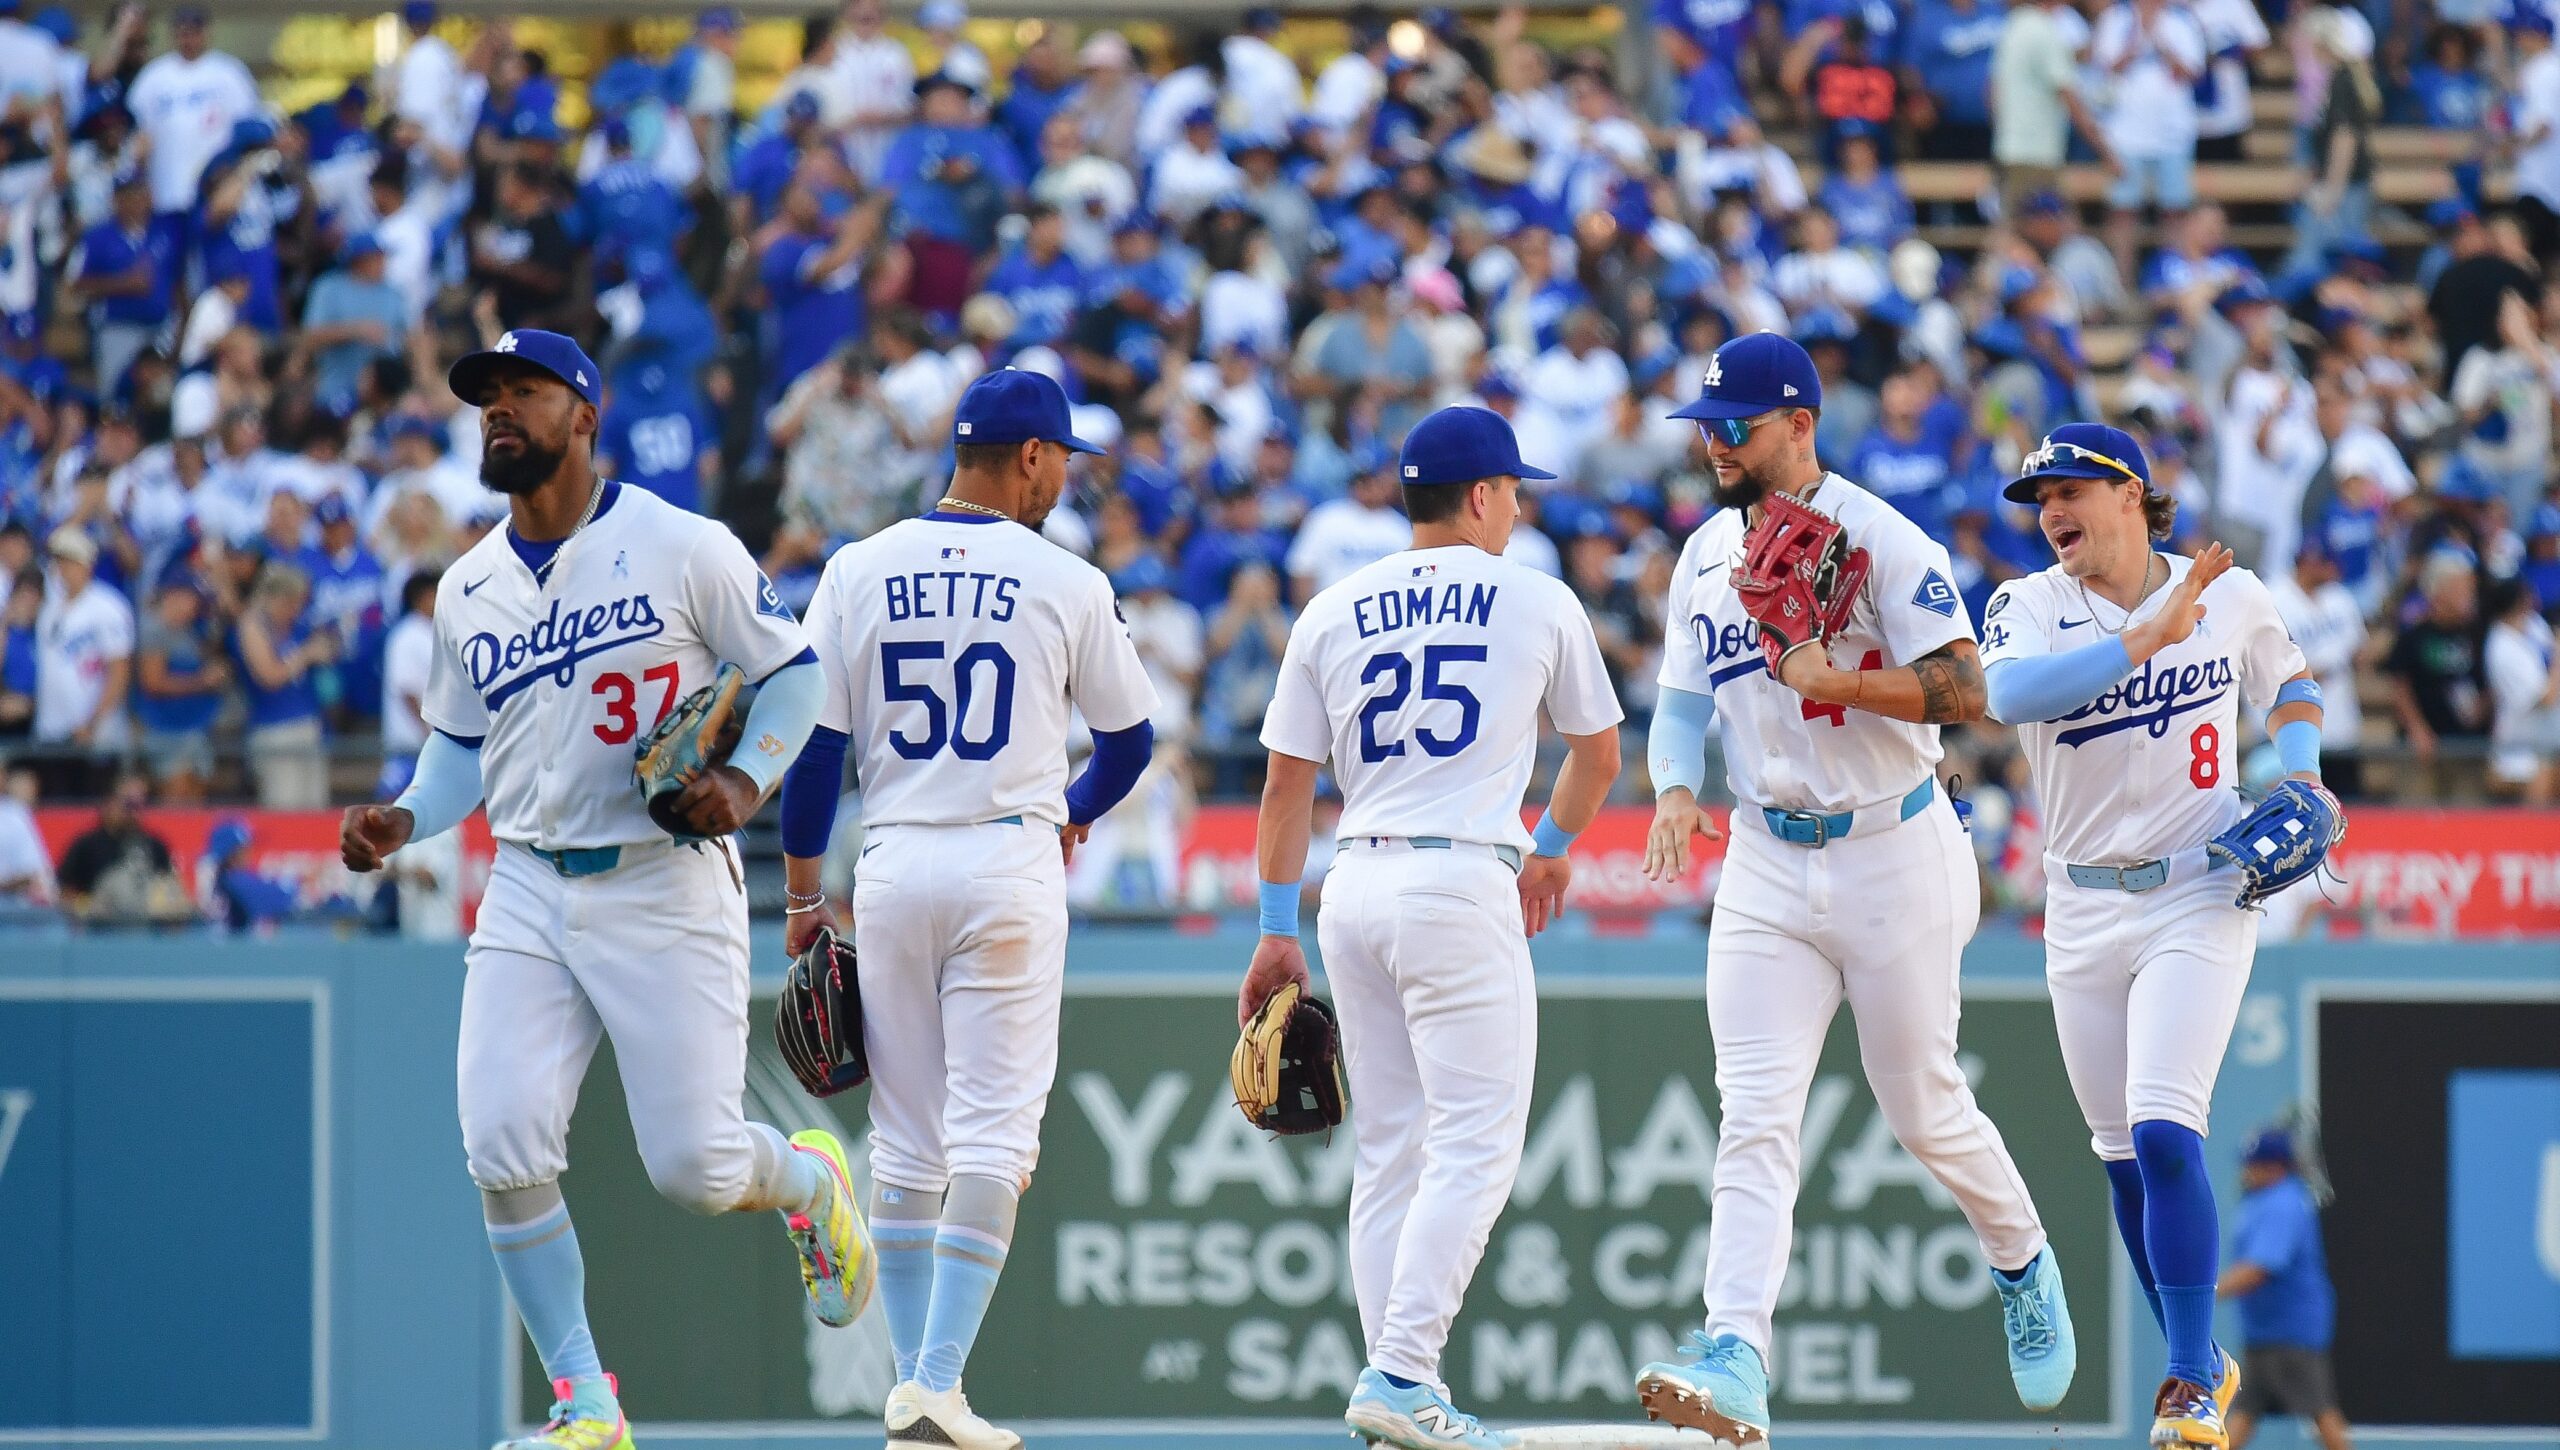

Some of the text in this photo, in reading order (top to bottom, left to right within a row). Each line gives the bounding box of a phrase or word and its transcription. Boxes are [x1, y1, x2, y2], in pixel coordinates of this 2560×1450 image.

[1703, 353, 1723, 386] LA
[885, 571, 1021, 622] BETTS
[1353, 582, 1498, 639] EDMAN
[1782, 595, 1801, 618] 44
[1926, 581, 1949, 600] G
[461, 594, 665, 713] Dodgers
[591, 661, 680, 745] 37
[880, 640, 1016, 761] 50
[1358, 644, 1488, 763] 25
[2044, 656, 2233, 749] odgers
[2190, 722, 2219, 789] 8
[2274, 836, 2314, 874] Rawlings
[1056, 1219, 1358, 1306] RESO
[1496, 1221, 1571, 1308] &
[1225, 1317, 1372, 1400] SA
